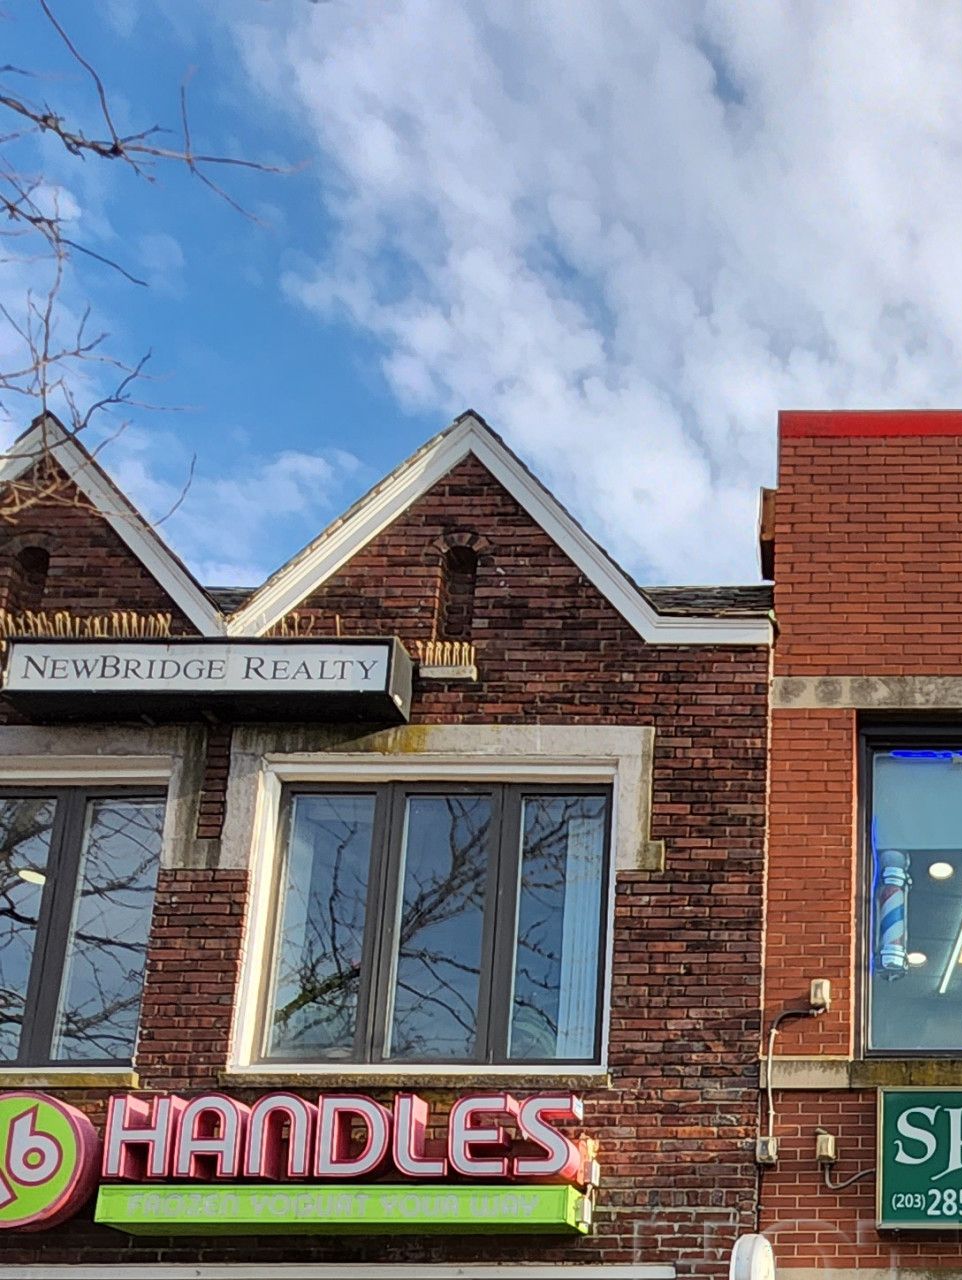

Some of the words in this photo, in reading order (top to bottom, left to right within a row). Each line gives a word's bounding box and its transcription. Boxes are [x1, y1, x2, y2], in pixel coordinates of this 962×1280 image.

[21, 654, 226, 680] NEWBRIDGE
[243, 656, 379, 681] REALTY
[101, 1092, 584, 1179] HANDLES
[126, 1193, 240, 1217] FROZEN
[250, 1193, 369, 1216] YOGURT
[381, 1193, 459, 1216] YOUR
[470, 1192, 541, 1216] WAY
[892, 1193, 926, 1211] (203)
